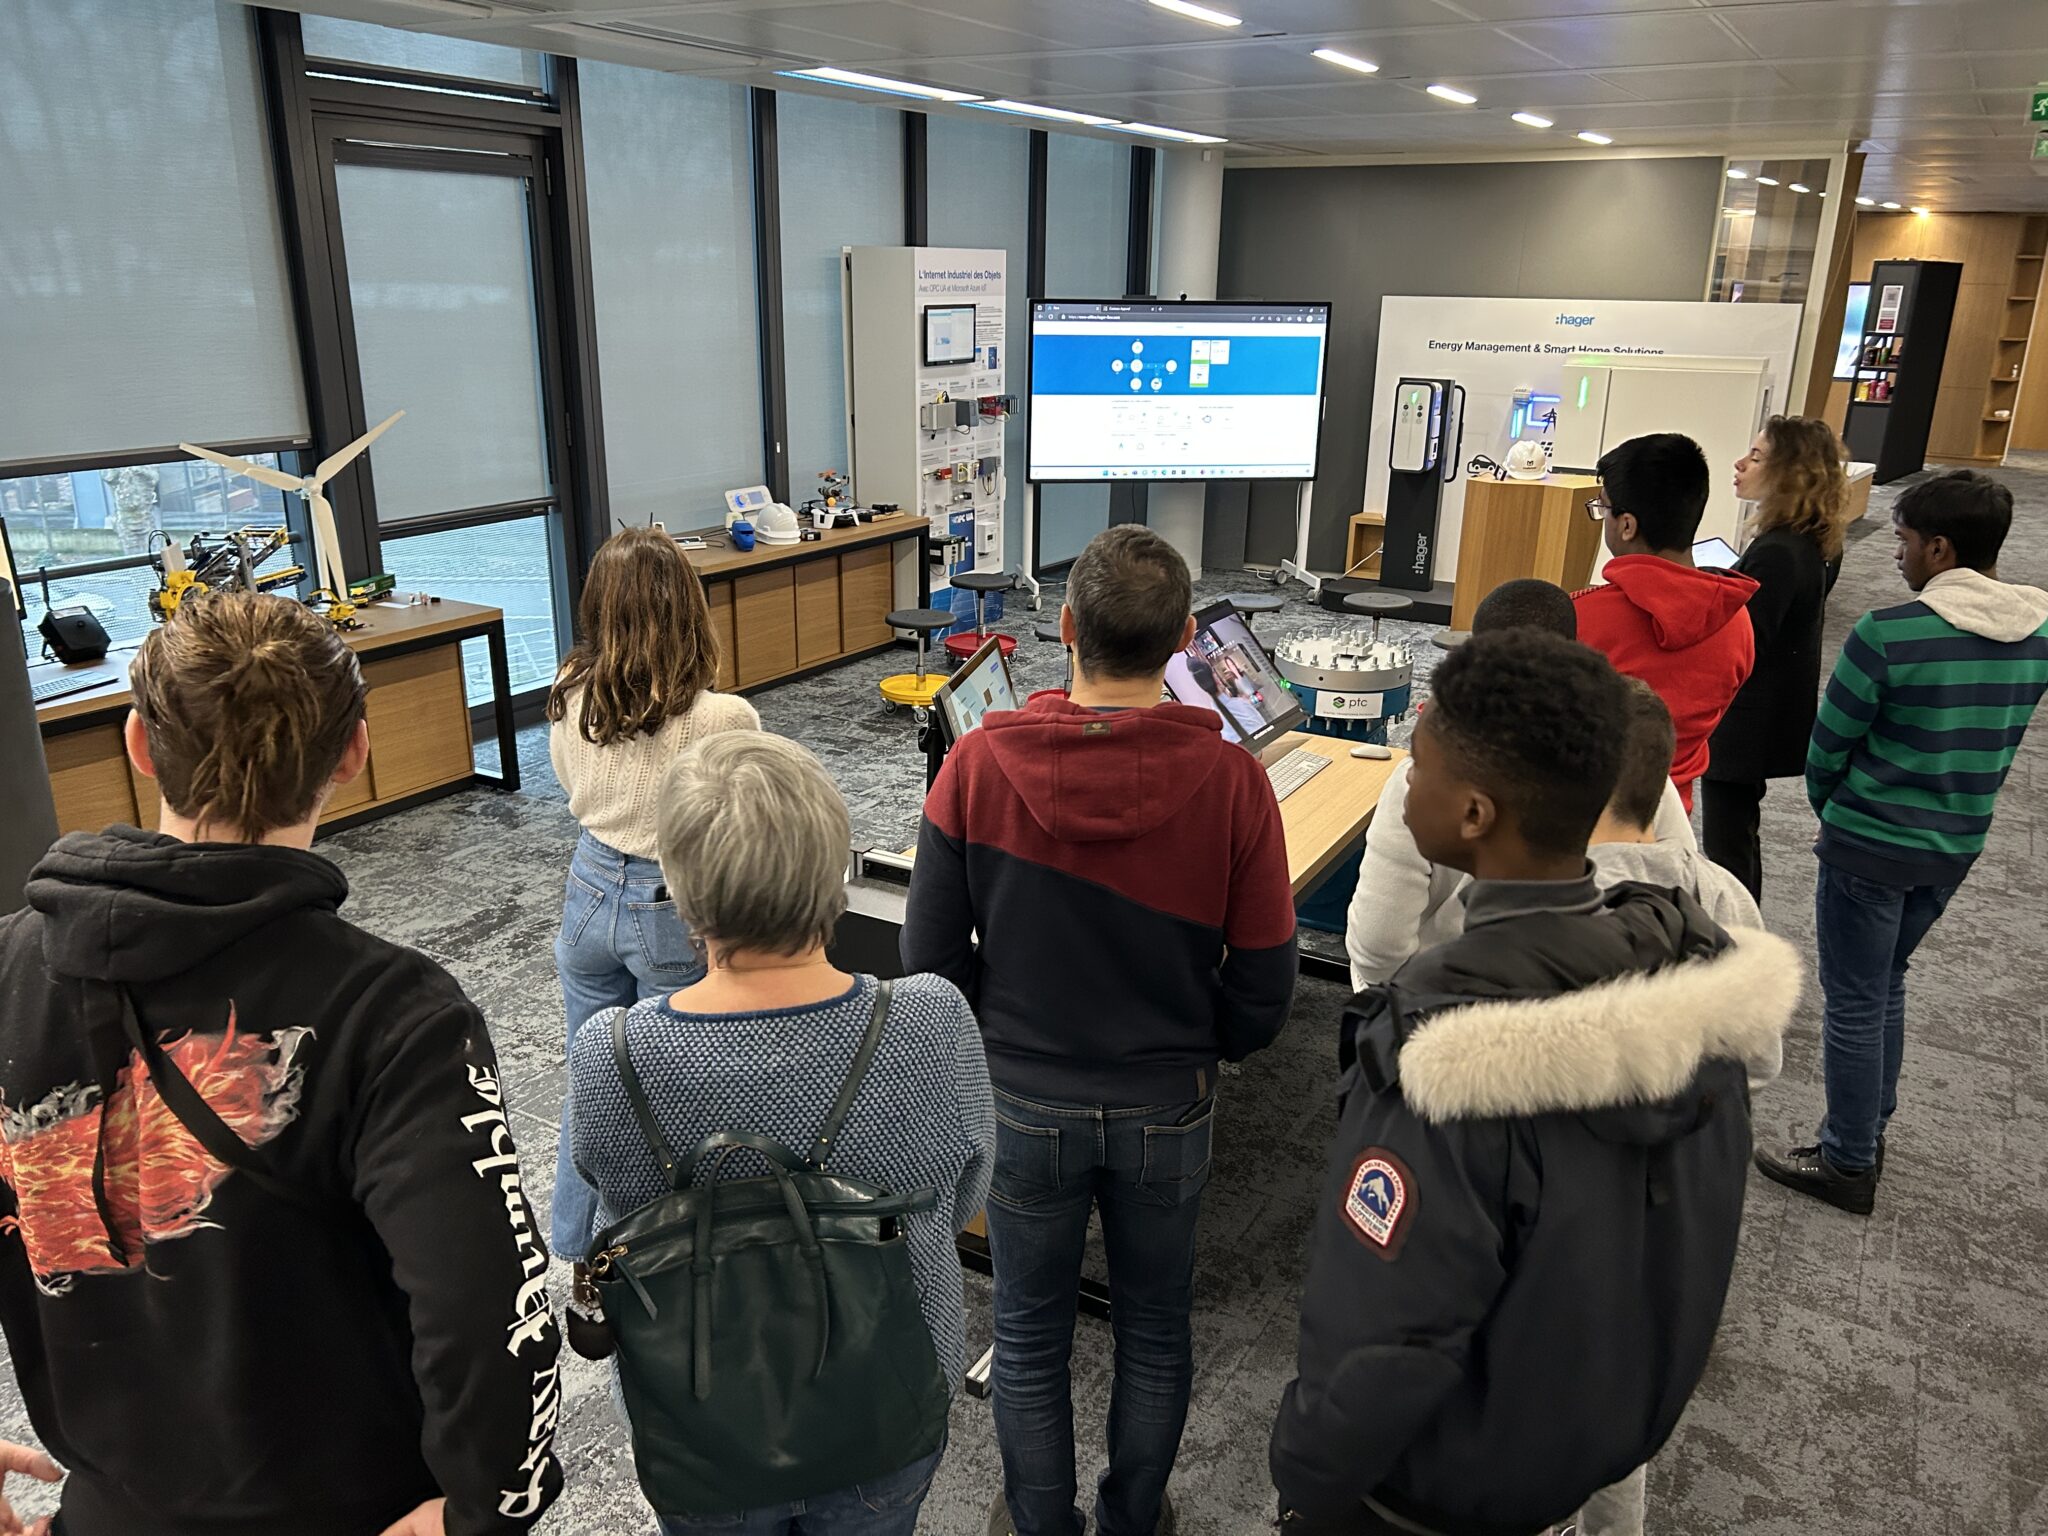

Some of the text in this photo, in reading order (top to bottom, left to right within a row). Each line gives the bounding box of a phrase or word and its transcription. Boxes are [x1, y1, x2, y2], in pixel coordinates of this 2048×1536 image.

[918, 269, 1002, 280] L'Internet Industriel des Objets
[1428, 339, 1463, 352] Energy
[1464, 341, 1532, 353] Management
[1533, 343, 1541, 353] &
[1543, 343, 1576, 354] Smart
[1349, 697, 1368, 709] ptc
